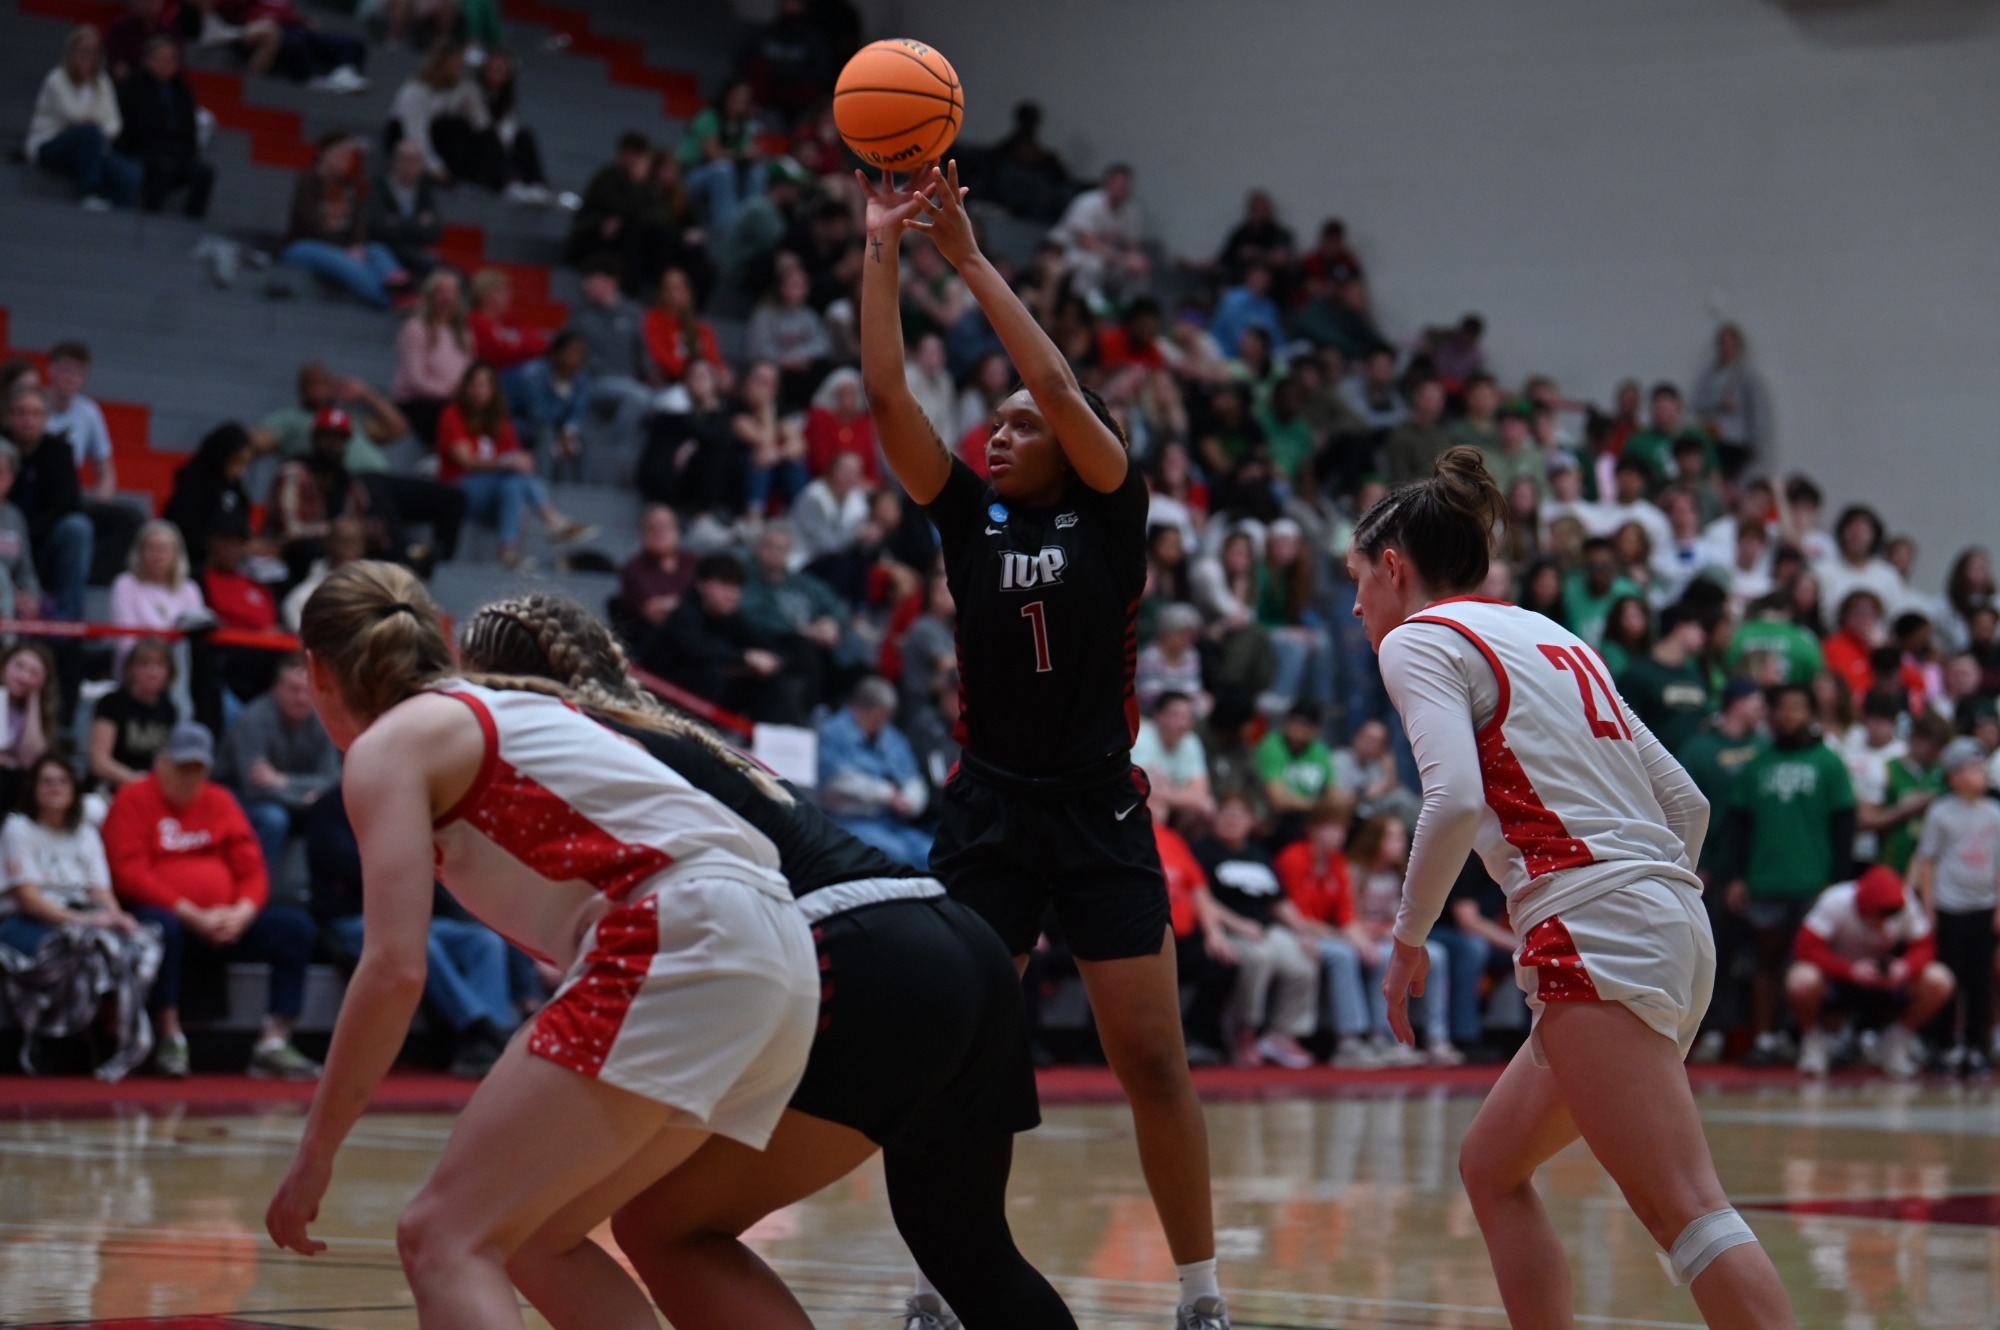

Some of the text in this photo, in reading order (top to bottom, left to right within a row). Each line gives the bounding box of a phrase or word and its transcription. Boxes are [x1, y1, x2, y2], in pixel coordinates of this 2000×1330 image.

[1001, 548, 1067, 588] IUP
[1020, 600, 1052, 672] 1
[1536, 643, 1633, 742] 21
